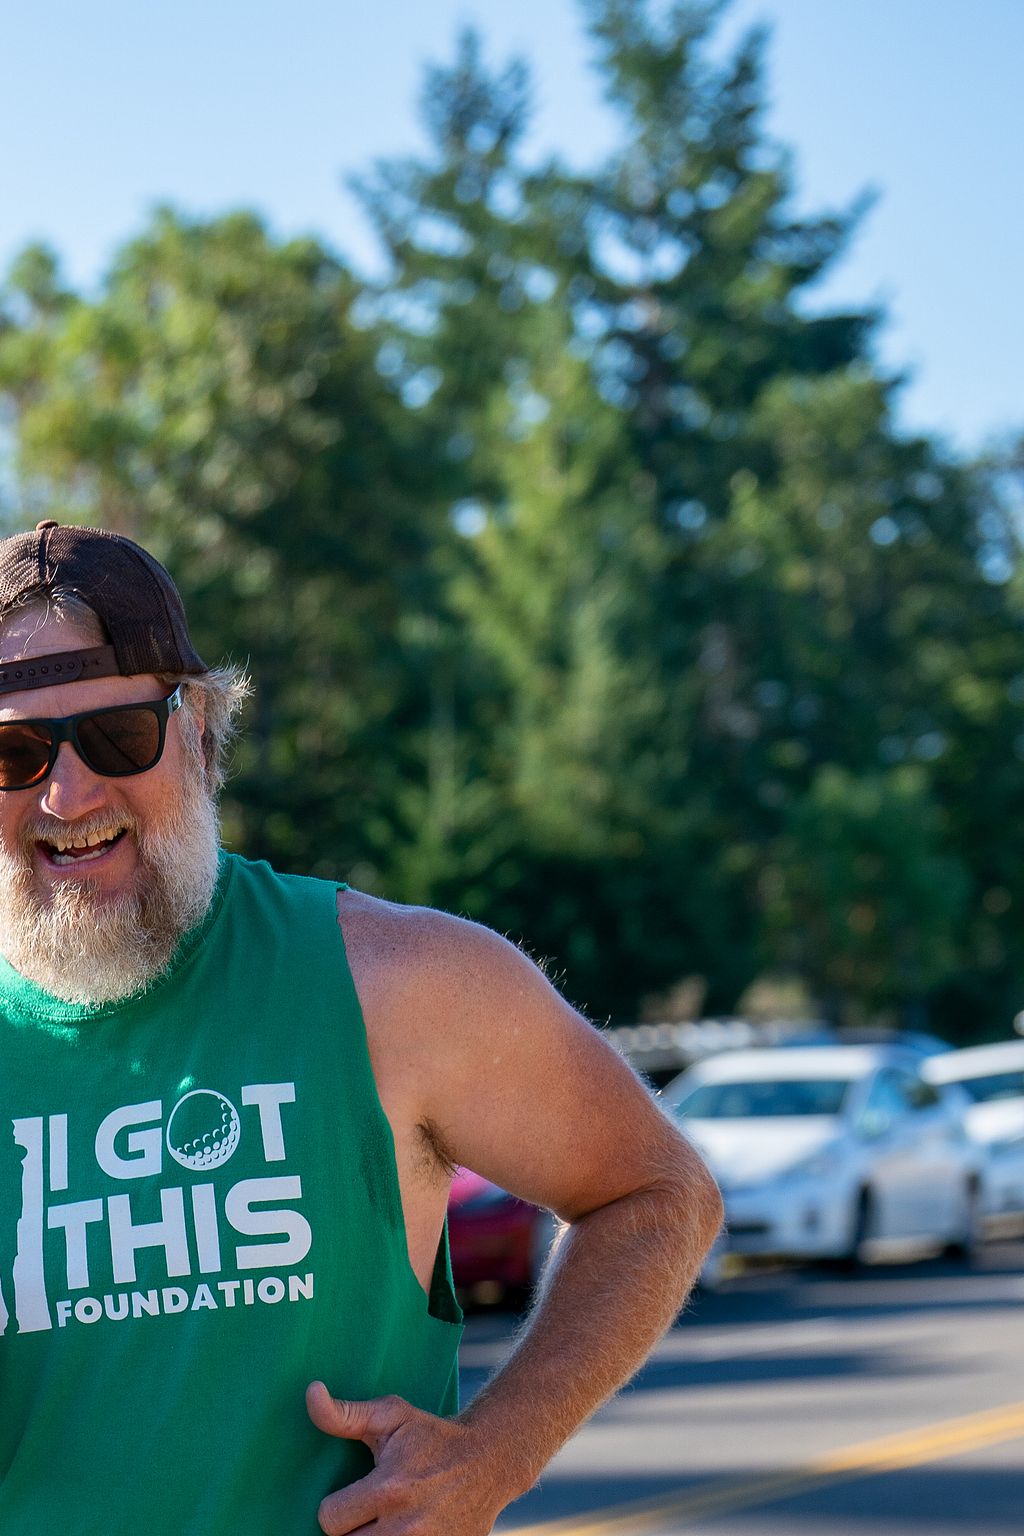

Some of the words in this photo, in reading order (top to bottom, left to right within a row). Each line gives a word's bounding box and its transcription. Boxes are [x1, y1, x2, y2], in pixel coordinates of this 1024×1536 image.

[48, 1113, 69, 1191] I
[94, 1082, 297, 1180] GOT
[47, 1175, 313, 1291] THIS
[55, 1272, 315, 1328] FOUNDATION
